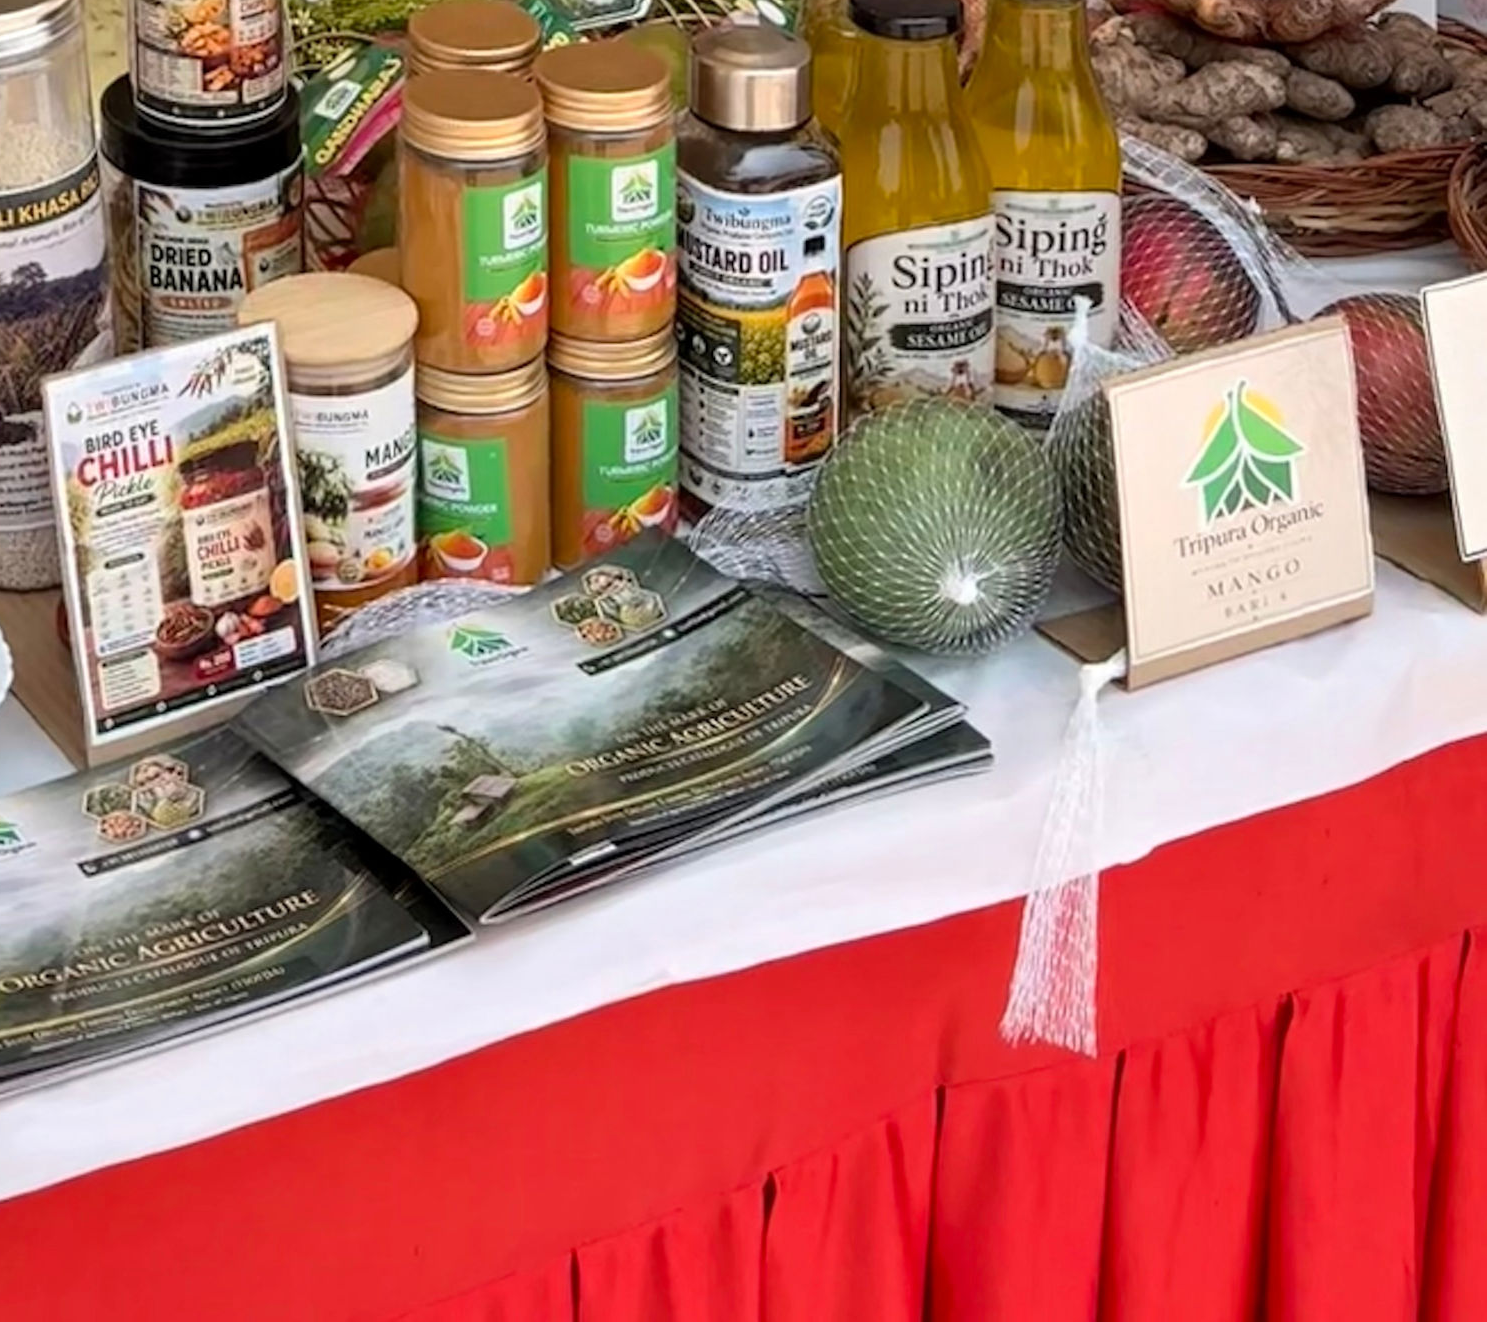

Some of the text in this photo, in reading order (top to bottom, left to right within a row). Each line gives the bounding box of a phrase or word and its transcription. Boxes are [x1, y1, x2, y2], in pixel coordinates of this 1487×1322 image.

[18, 189, 80, 224] KHASA
[996, 213, 1107, 257] Siping
[149, 243, 213, 268] DRIED
[759, 248, 790, 274] OIL
[1001, 255, 1093, 279] ni Thok
[149, 264, 244, 293] BANANA
[903, 295, 928, 315] ni
[905, 329, 965, 349] SESAME
[85, 419, 160, 454] BIRD EYE
[77, 434, 174, 487] CHILLI
[94, 474, 155, 506] Pickle
[1174, 526, 1248, 559] Tripura
[1250, 500, 1326, 537] Organic
[197, 536, 240, 561] CHILLI
[1207, 557, 1303, 599] MANGO
[565, 674, 812, 777] ORGANIC AGRICULTURE
[136, 887, 320, 963] AGRICULTURE
[244, 920, 309, 950] TRIPURA
